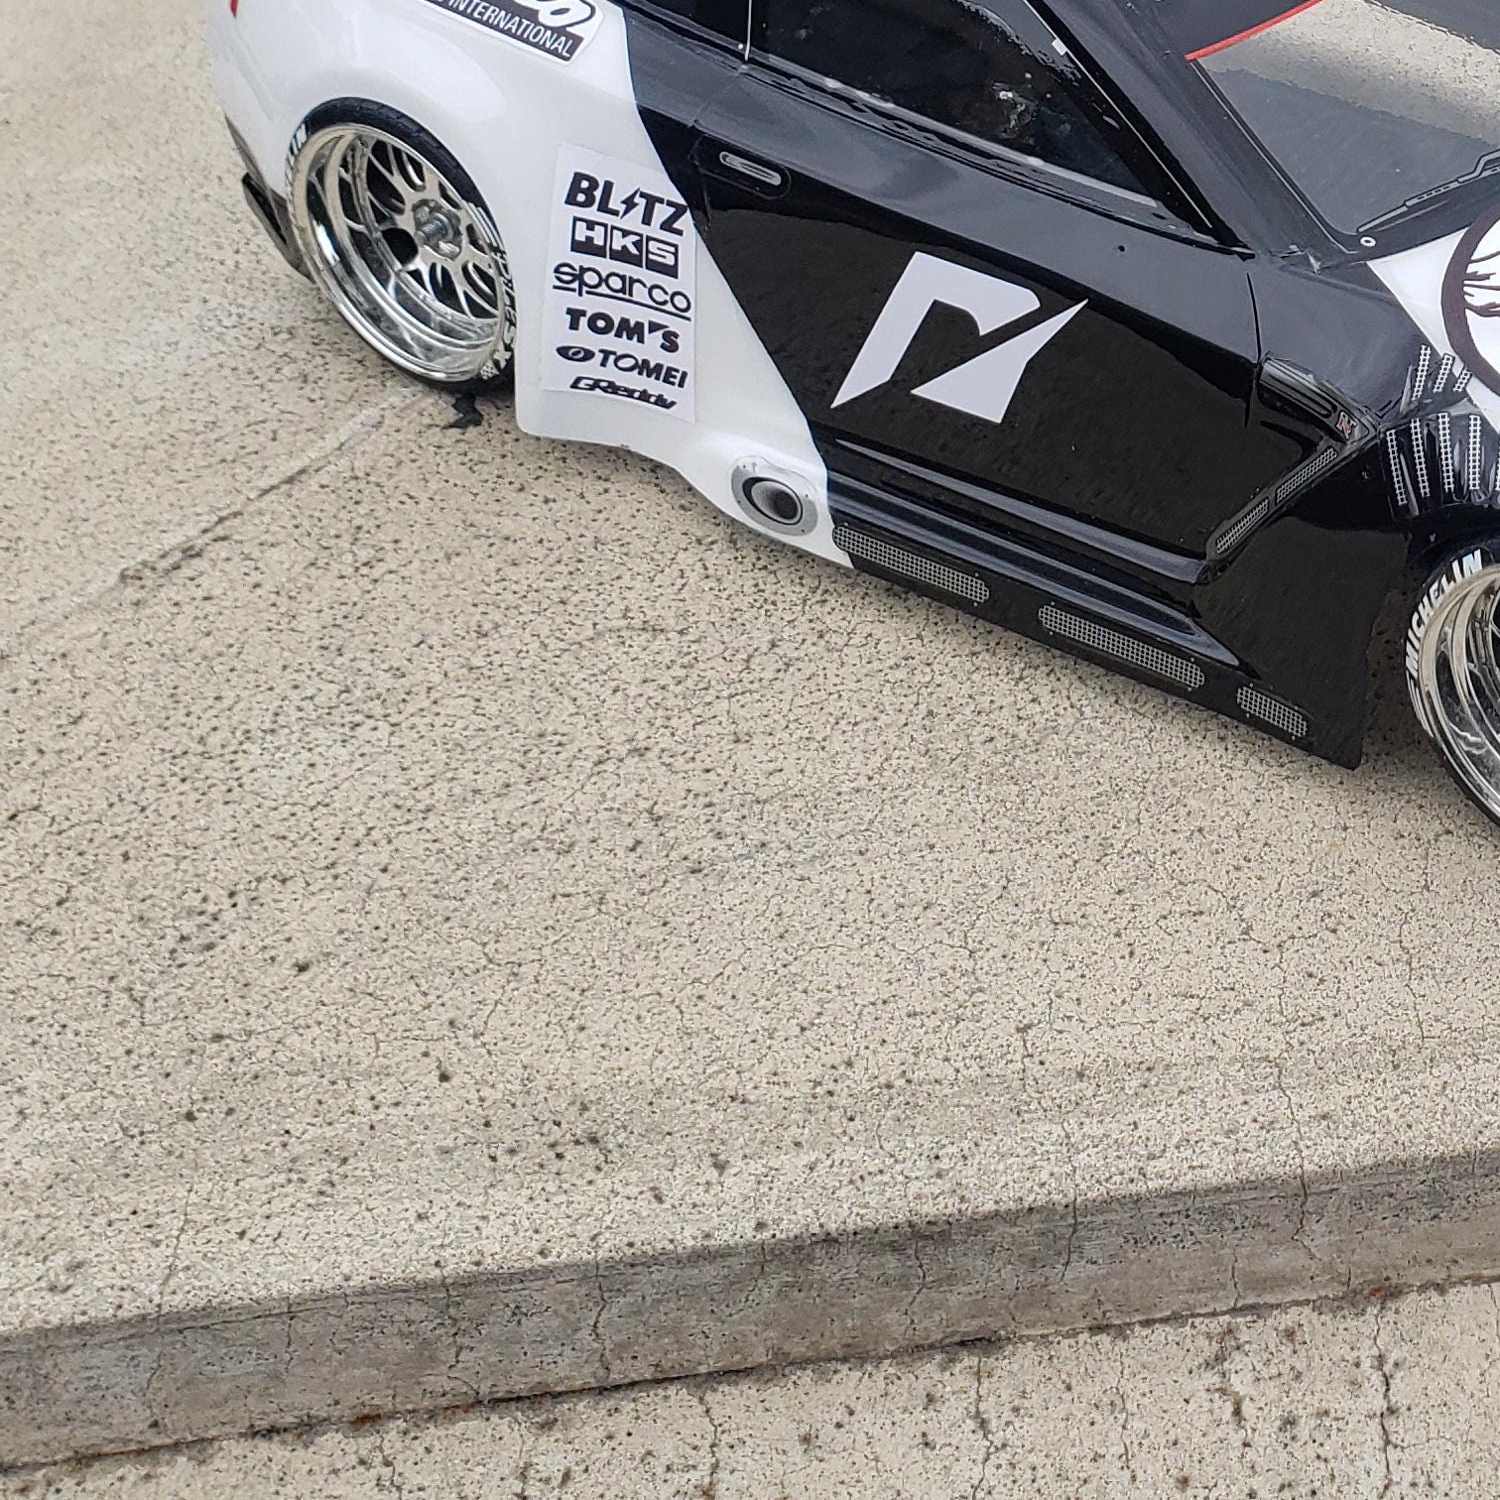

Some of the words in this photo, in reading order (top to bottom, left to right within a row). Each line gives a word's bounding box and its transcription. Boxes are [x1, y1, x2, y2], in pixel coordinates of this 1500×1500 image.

[564, 171, 688, 236] BLITZ
[571, 215, 679, 279] HKS
[552, 262, 692, 315] sparco
[598, 348, 688, 388] TOMEI
[1404, 548, 1484, 681] MICHELIN
